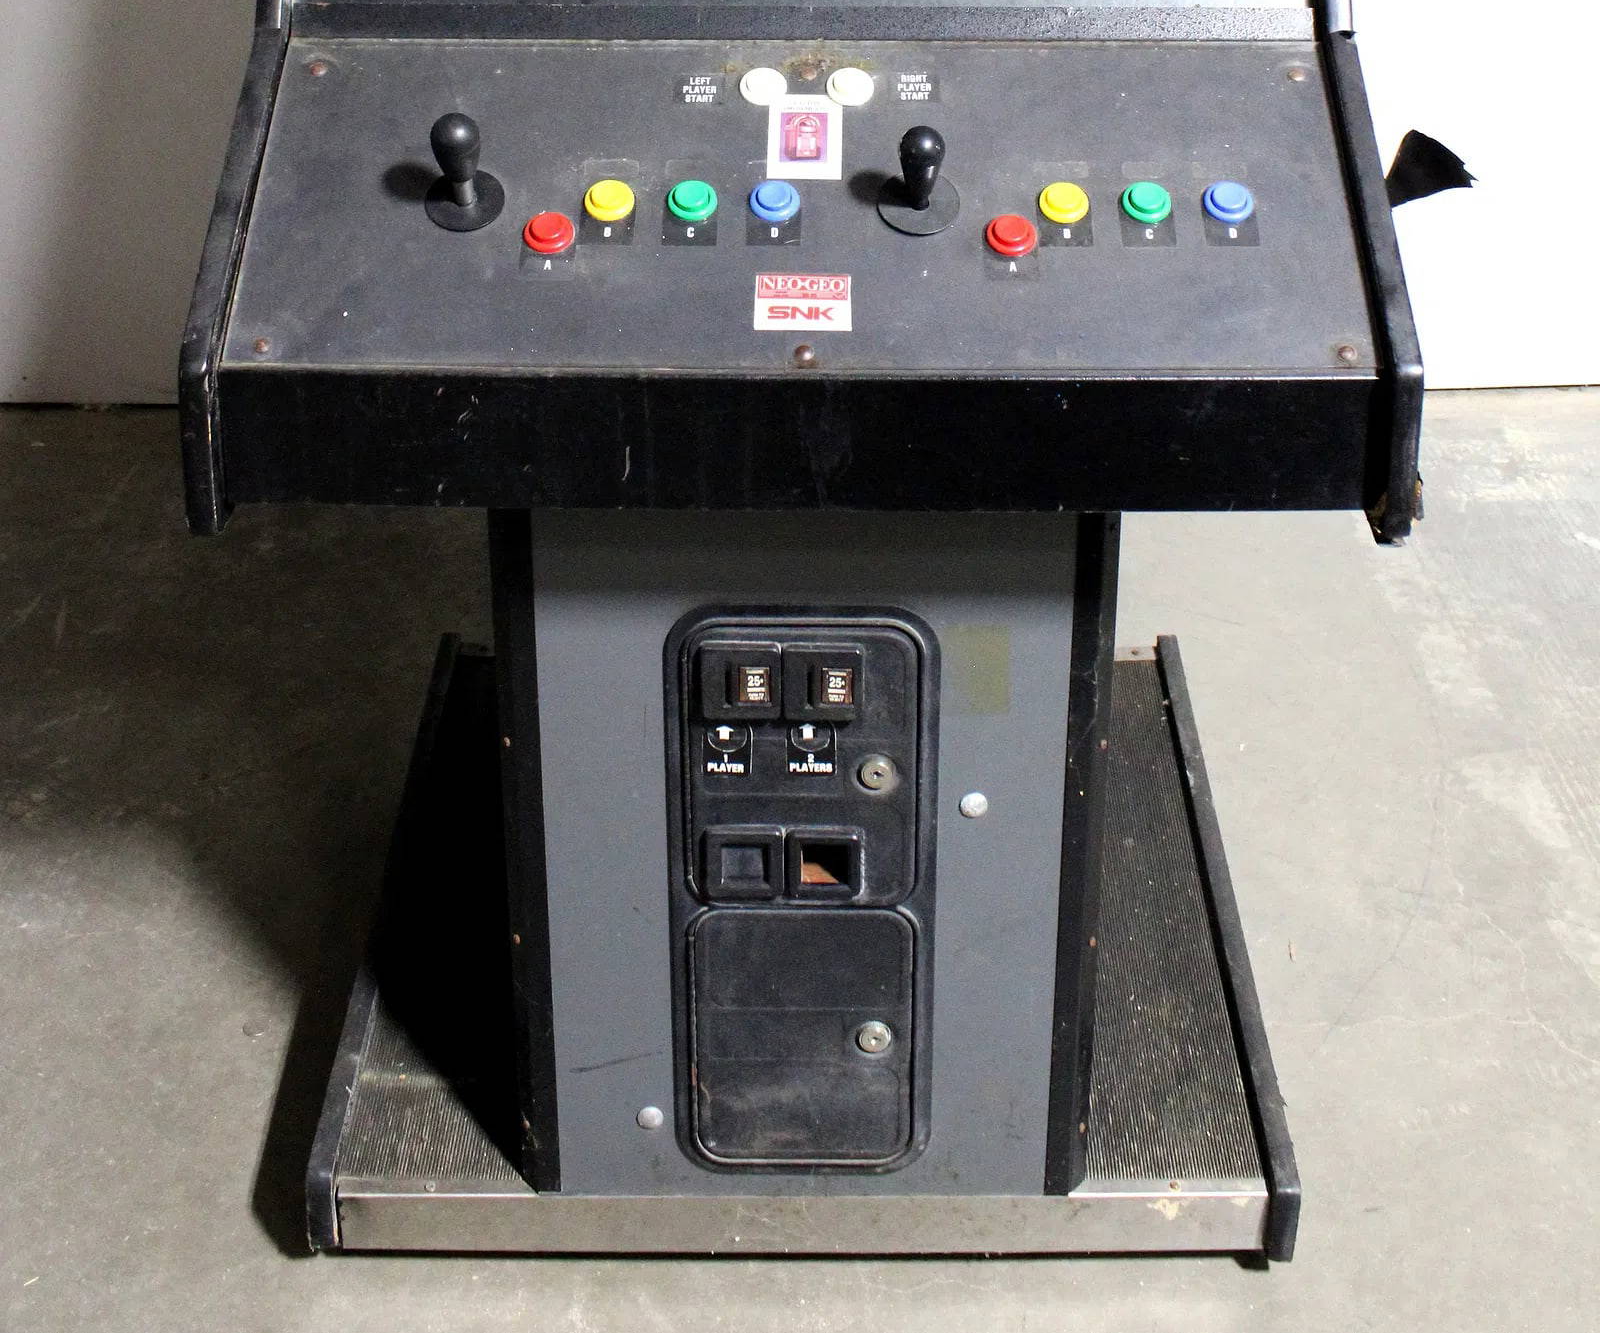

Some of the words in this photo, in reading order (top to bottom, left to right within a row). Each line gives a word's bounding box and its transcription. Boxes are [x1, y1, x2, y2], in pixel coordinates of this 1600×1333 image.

[689, 77, 712, 86] LEFT
[901, 74, 928, 83] RIGHT
[682, 85, 717, 94] PLAYER
[897, 83, 932, 92] PLAYER
[685, 94, 715, 103] START
[900, 92, 930, 101] START
[603, 226, 612, 238] B
[686, 226, 695, 238] C
[770, 226, 779, 238] D
[1063, 228, 1072, 239] B
[1145, 228, 1154, 240] C
[1228, 227, 1238, 239] D
[543, 259, 552, 270] A
[1008, 261, 1018, 272] A
[767, 305, 836, 321] SNK
[723, 753, 729, 763] 1
[806, 753, 815, 763] 2
[707, 762, 745, 773] PLAYER
[789, 763, 833, 773] PLAYERS
